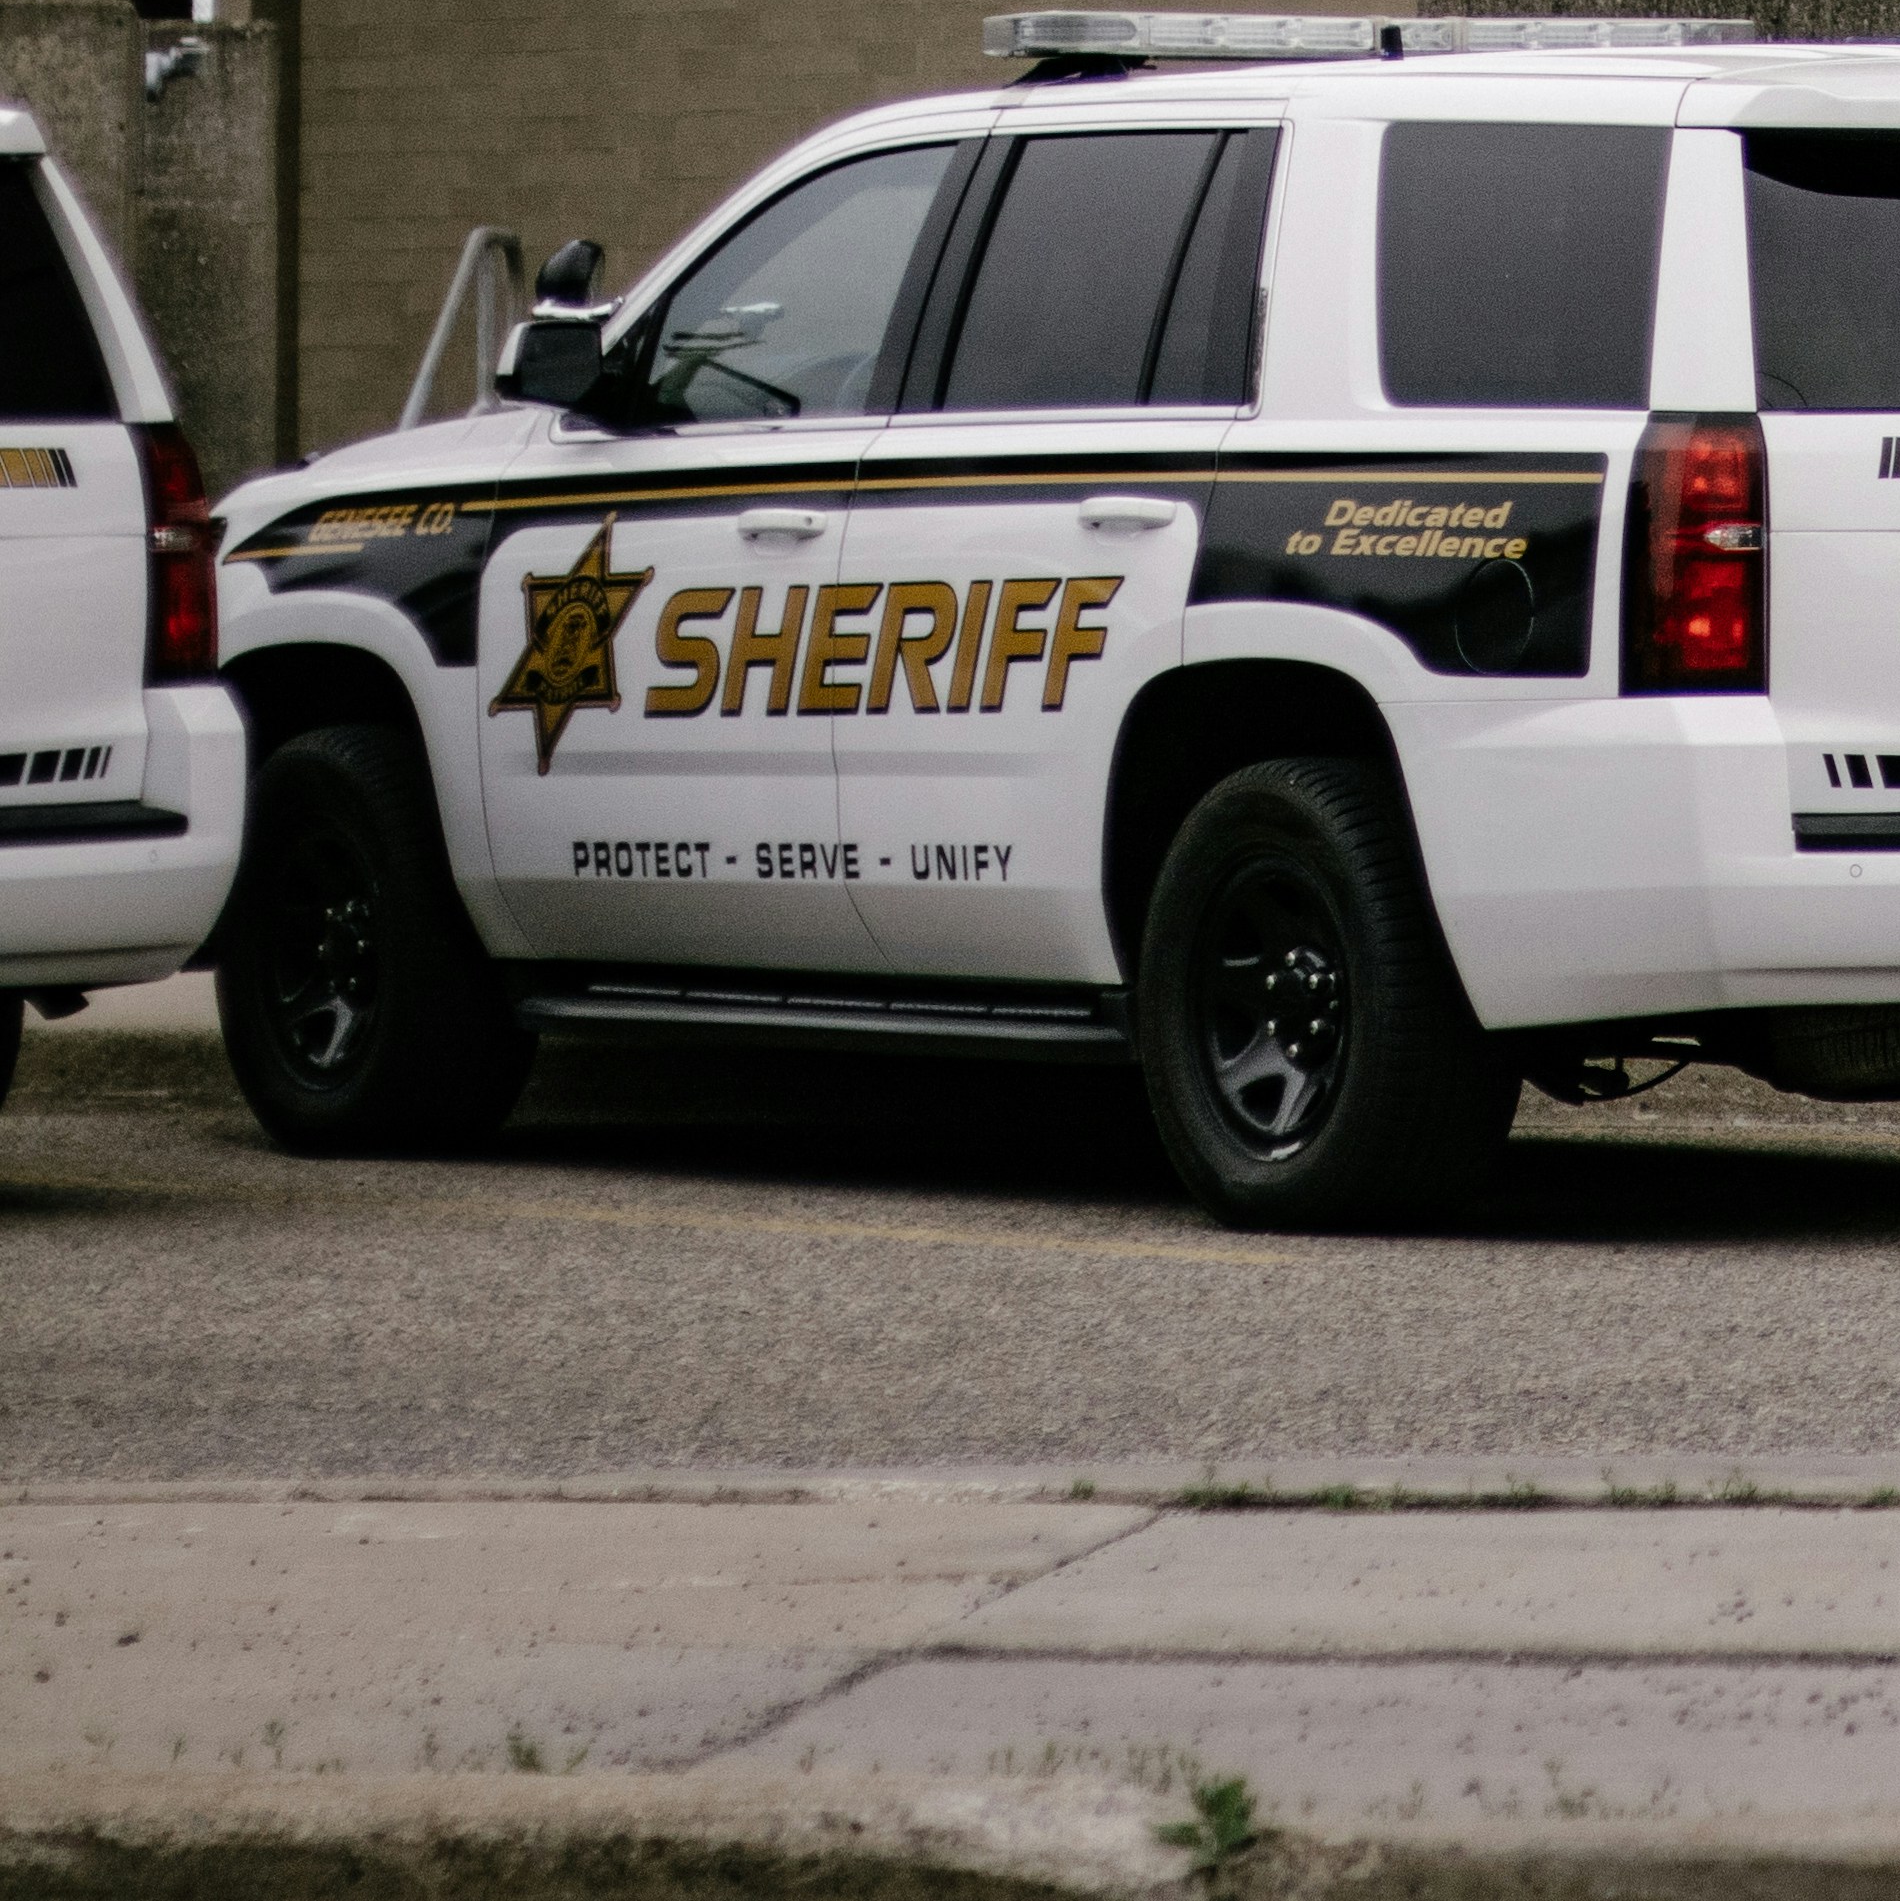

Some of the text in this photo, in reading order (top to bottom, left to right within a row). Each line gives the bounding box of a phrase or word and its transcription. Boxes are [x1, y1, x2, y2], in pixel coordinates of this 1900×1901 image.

[1323, 499, 1514, 529] Dedicated
[1285, 528, 1530, 559] to Excellence
[644, 575, 1125, 718] SHERIFF
[573, 841, 710, 879] PROTECT
[756, 843, 860, 880] SERVE
[911, 844, 1014, 882] UNIFY
